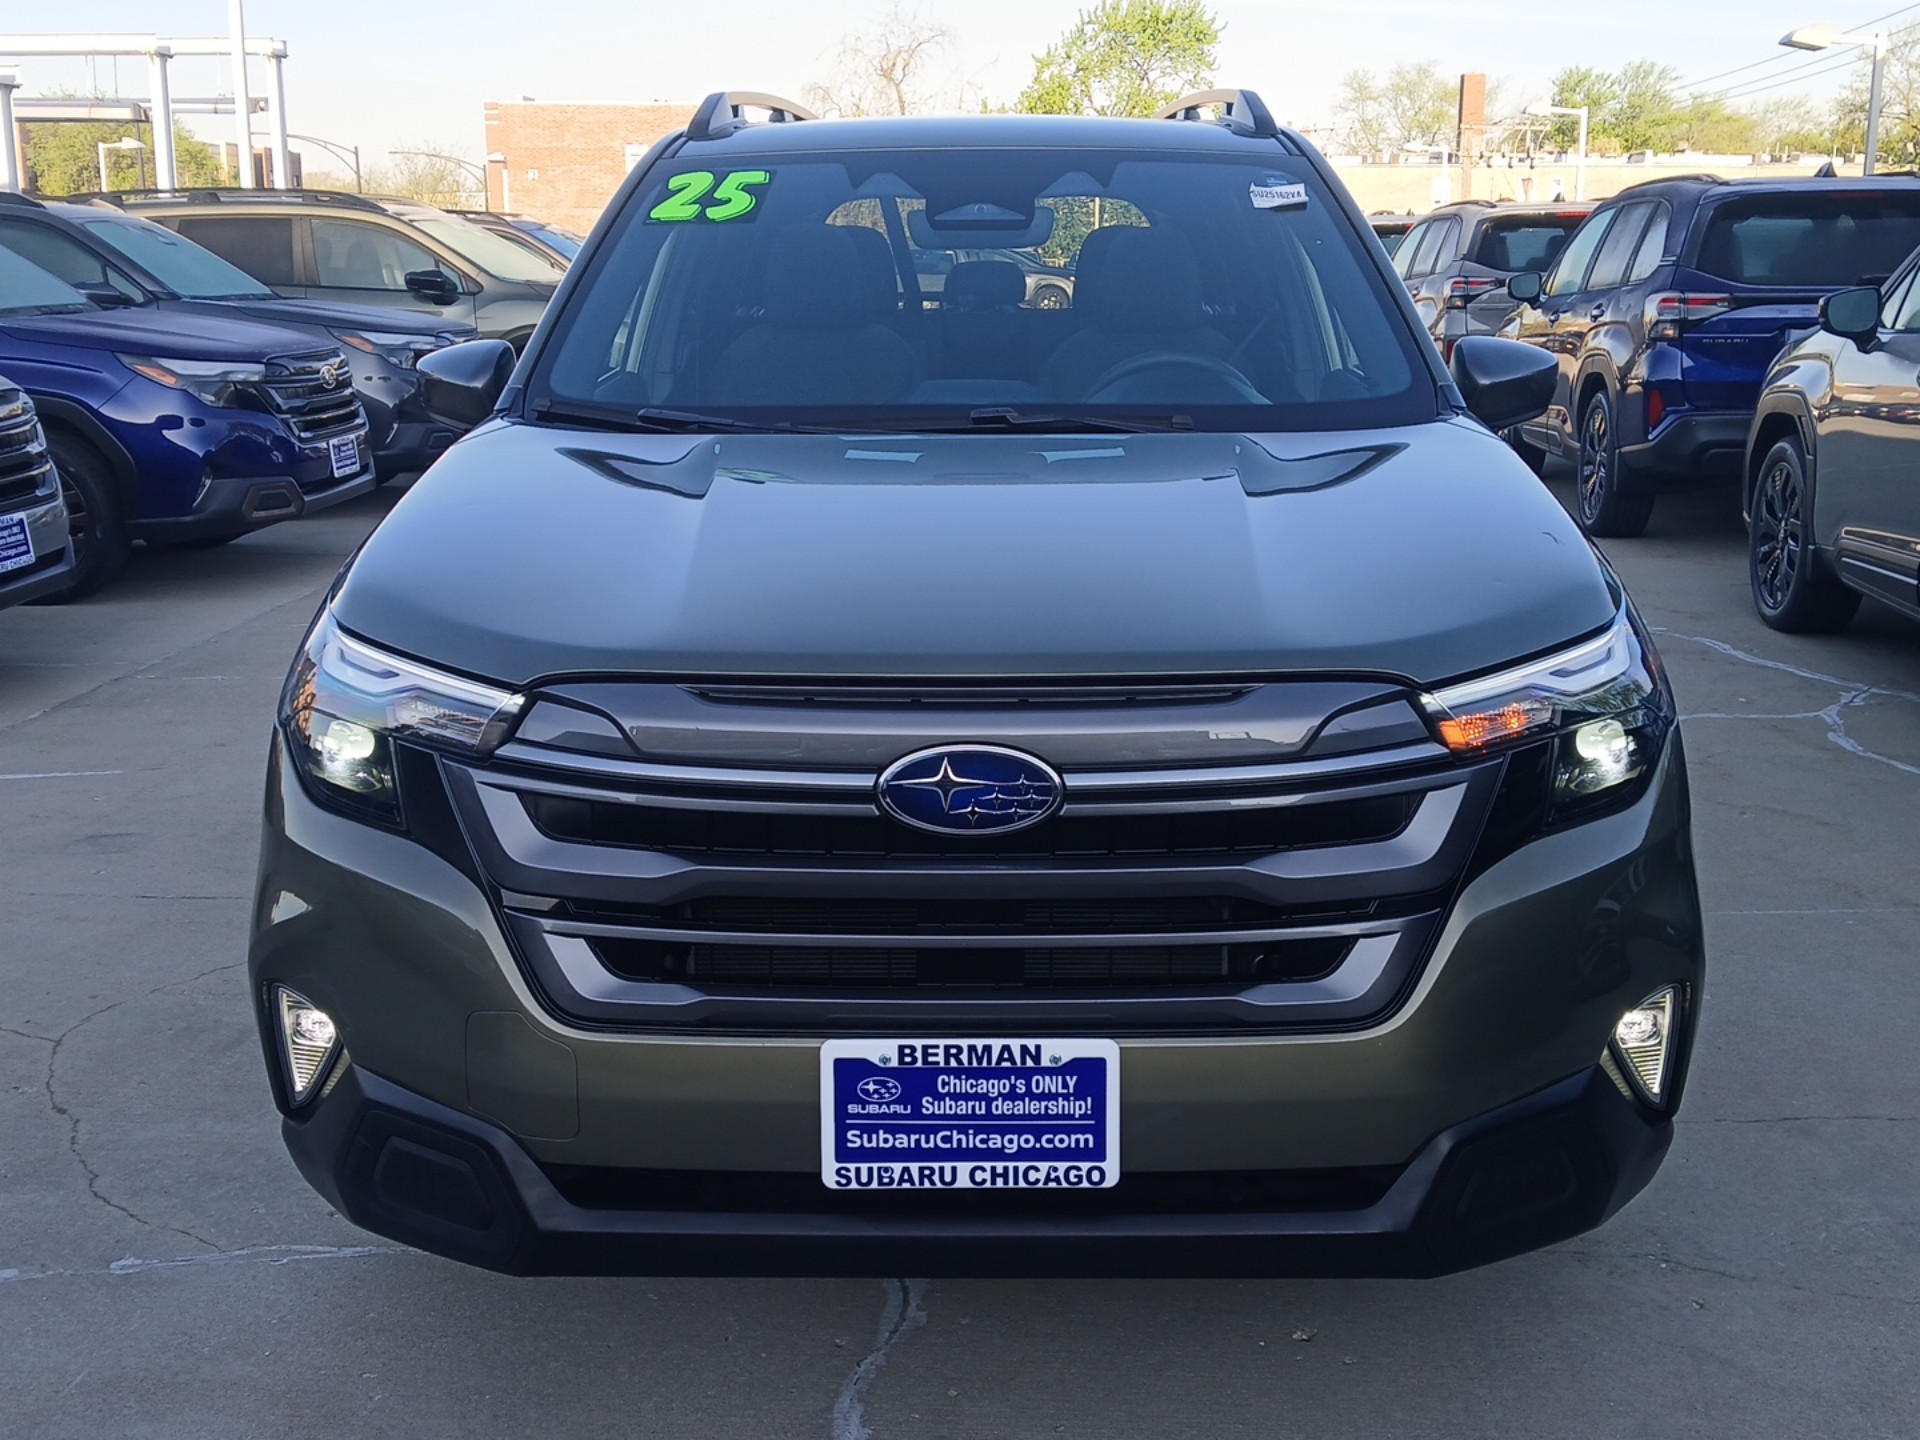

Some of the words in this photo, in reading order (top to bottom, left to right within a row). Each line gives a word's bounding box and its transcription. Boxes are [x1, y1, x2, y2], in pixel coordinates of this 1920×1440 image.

[649, 170, 770, 222] 25
[897, 1044, 1042, 1066] BERMAN
[937, 1075, 1026, 1097] Chicago's
[1031, 1075, 1078, 1094] ONLY
[847, 1104, 911, 1114] SUBARU
[921, 1096, 986, 1115] Subaru
[991, 1096, 1092, 1118] dealership!
[846, 1129, 1094, 1153] SubaruChicago.com
[835, 1165, 958, 1188] SUBARU
[969, 1164, 1107, 1187] CHICAGO
